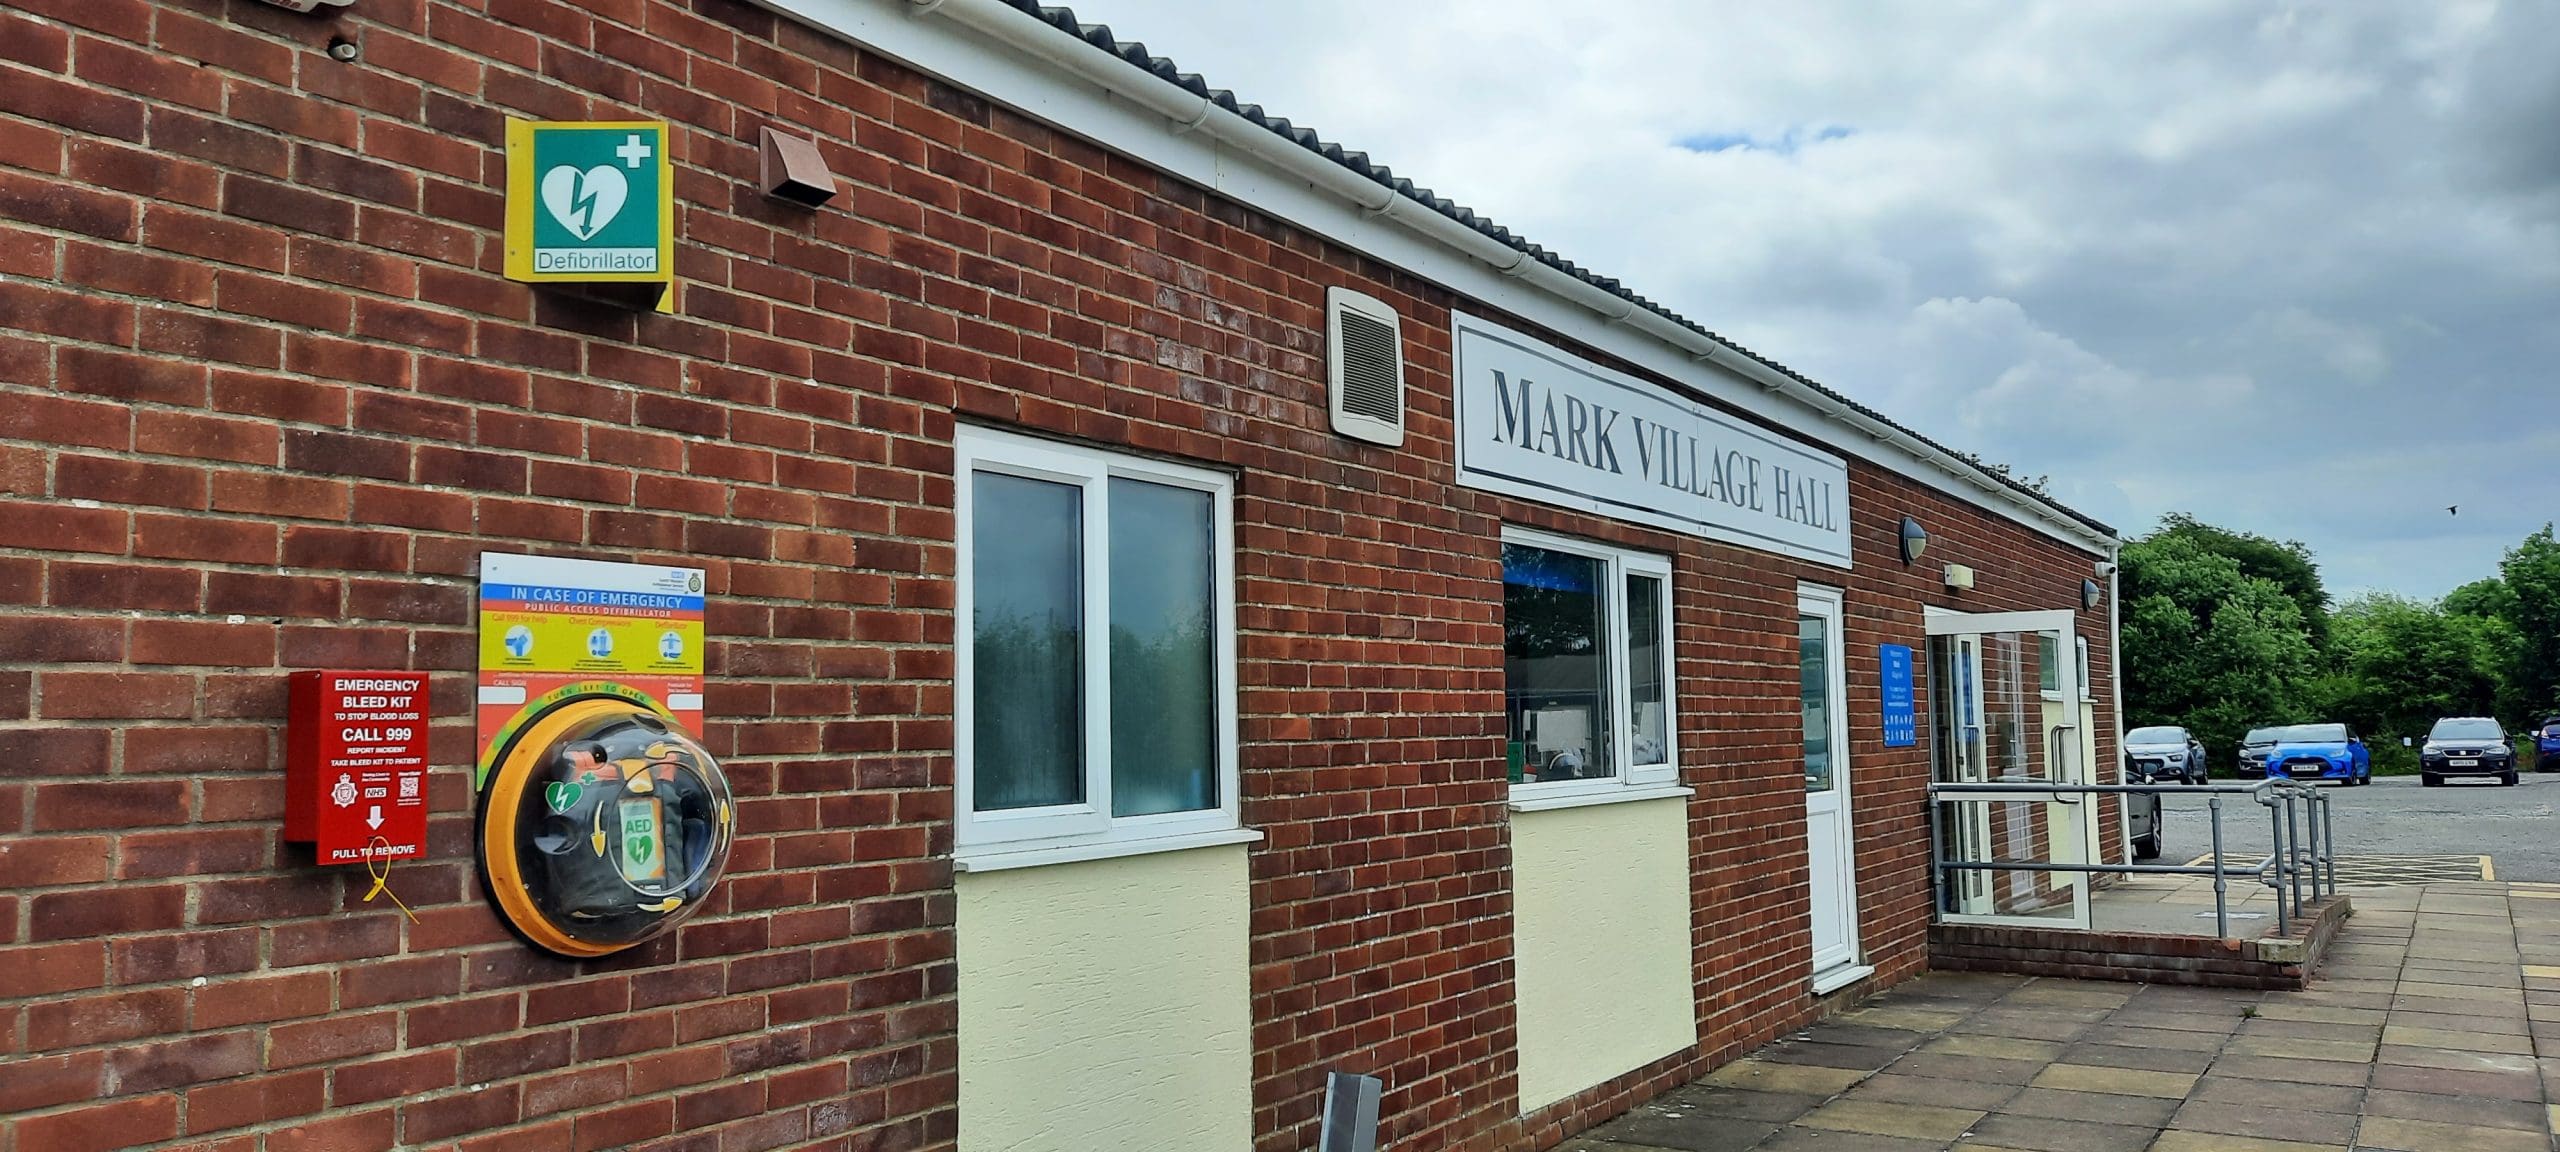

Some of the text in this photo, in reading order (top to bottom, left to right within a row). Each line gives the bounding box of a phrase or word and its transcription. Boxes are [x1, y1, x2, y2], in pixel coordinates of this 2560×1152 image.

[538, 252, 653, 269] Defibrillator
[1489, 368, 1838, 533] MARK VILLAGE HALL
[511, 587, 683, 609] IN CASE OF EMERGENCY
[525, 602, 671, 617] PUBLIC ACCESS DEFIBRILLATOR
[335, 679, 419, 691] EMERGENCY
[547, 684, 646, 702] TURN LEFT TO OPEN
[343, 696, 412, 708] BLEED KIT
[398, 712, 419, 720] LOSS
[342, 728, 412, 741] CALL 999
[394, 757, 421, 765] PATIENT
[366, 788, 385, 797] NHS
[625, 819, 653, 834] AED
[332, 844, 416, 859] PULL TO REMOVE
